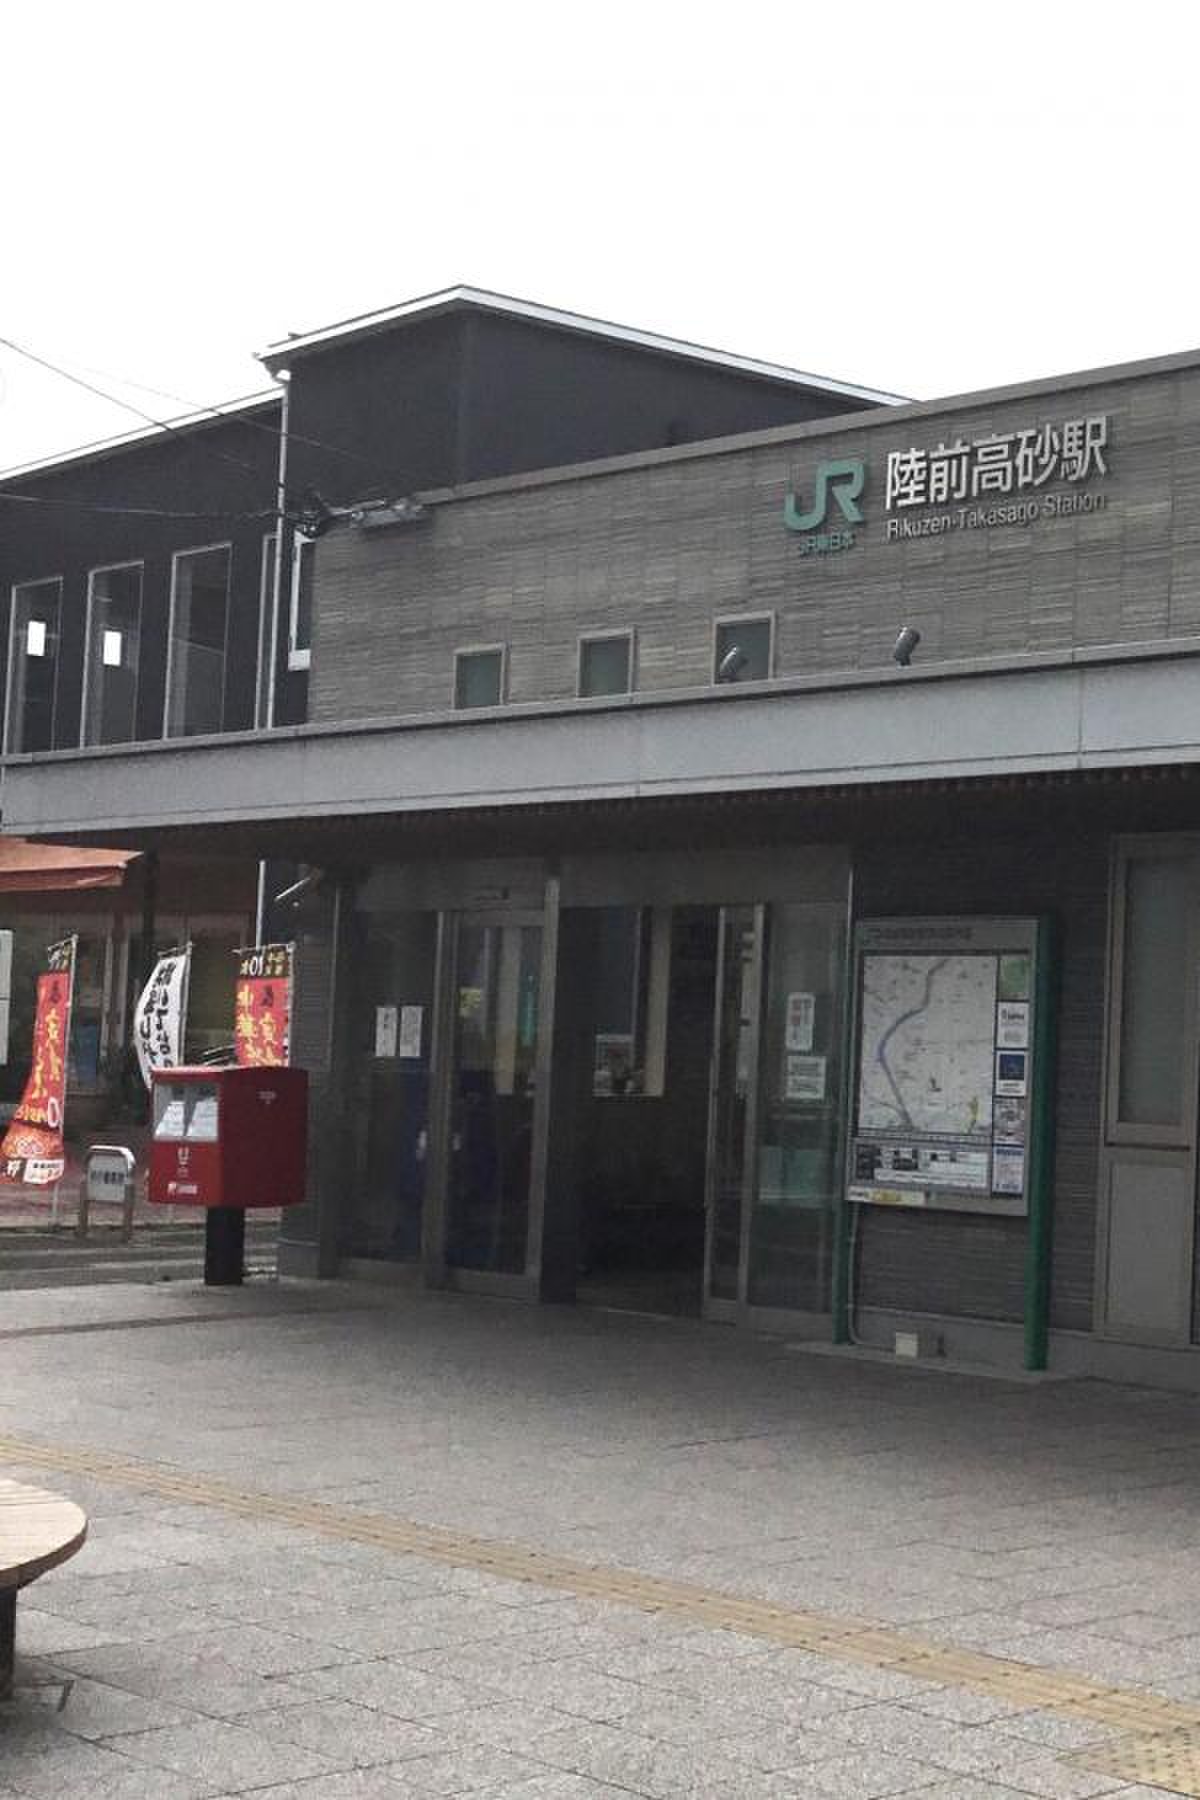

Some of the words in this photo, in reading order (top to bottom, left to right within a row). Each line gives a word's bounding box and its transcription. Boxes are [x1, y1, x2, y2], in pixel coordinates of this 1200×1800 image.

[784, 459, 865, 531] JR
[886, 415, 1107, 511] 陸前高砂駅
[1043, 493, 1106, 514] Station
